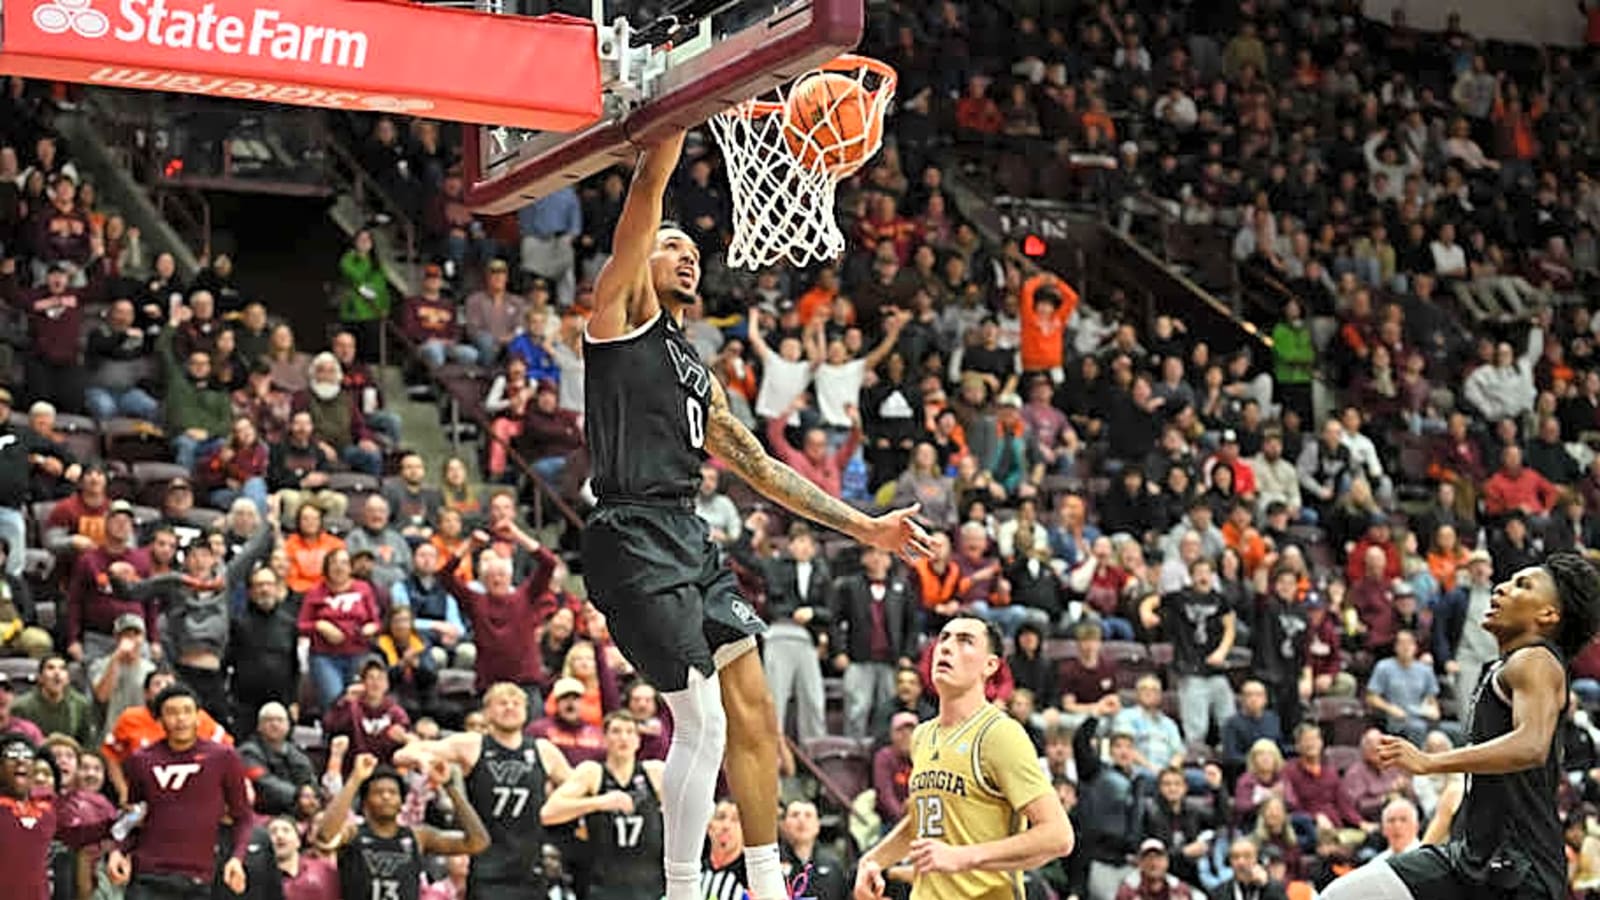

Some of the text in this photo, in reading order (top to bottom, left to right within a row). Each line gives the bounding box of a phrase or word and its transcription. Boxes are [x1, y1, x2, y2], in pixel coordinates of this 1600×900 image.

[686, 396, 704, 448] 0
[324, 592, 362, 612] VT
[152, 763, 201, 790] VT
[910, 770, 966, 797] EORGIA
[493, 787, 530, 817] 77
[917, 795, 944, 838] 12
[616, 815, 643, 847] 17
[371, 879, 400, 900] 13
